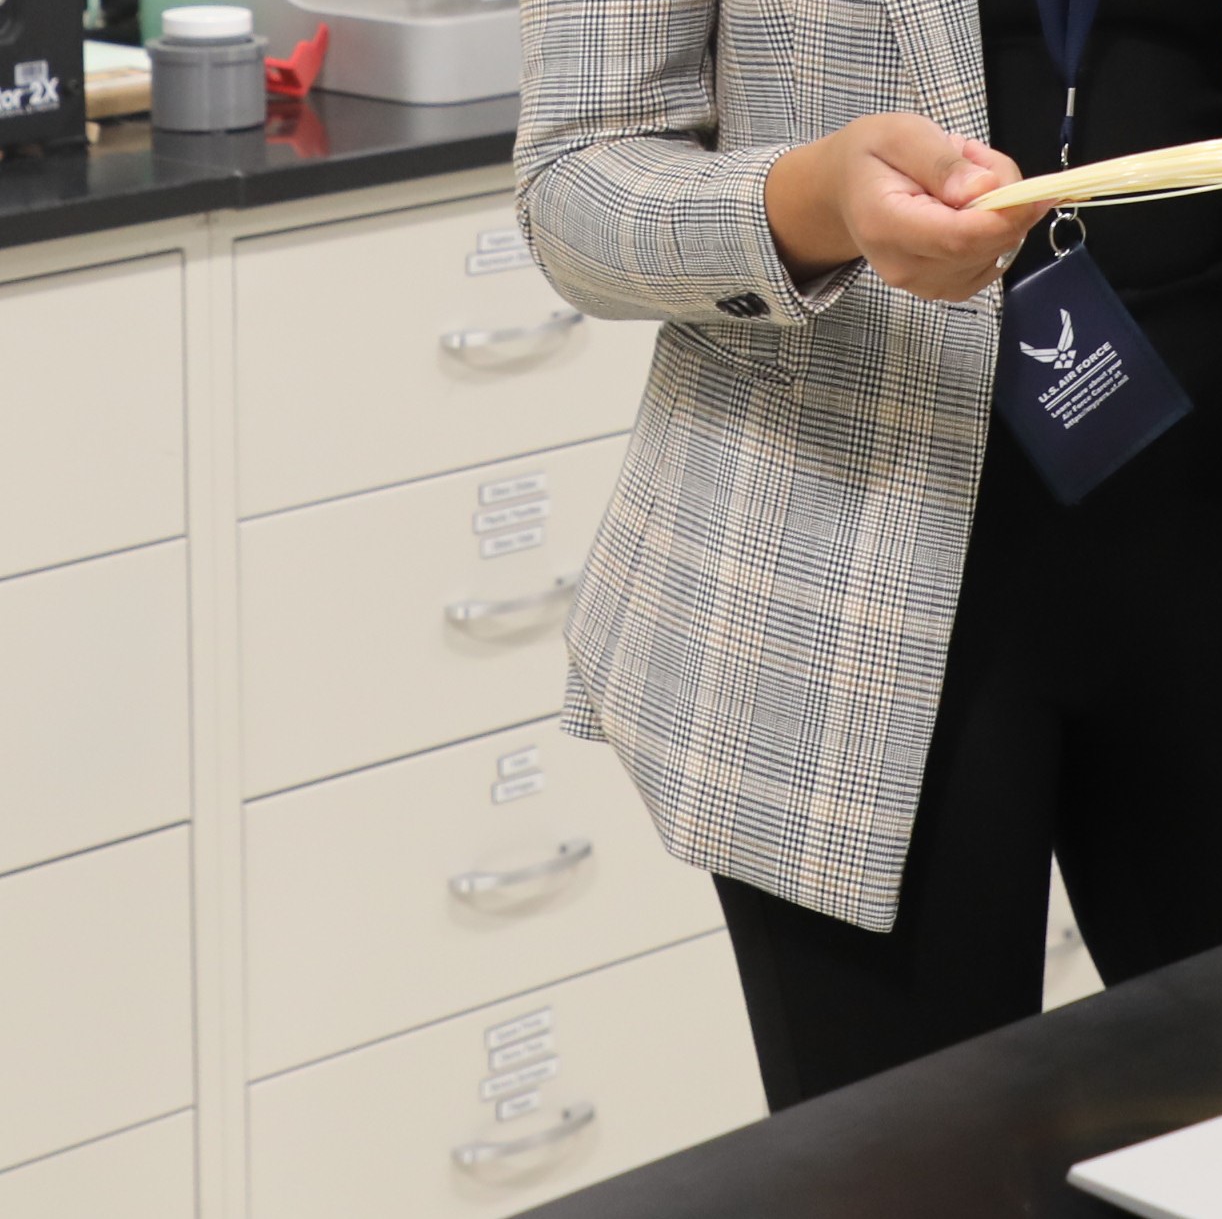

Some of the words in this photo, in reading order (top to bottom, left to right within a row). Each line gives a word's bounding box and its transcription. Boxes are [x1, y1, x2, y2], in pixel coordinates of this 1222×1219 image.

[28, 77, 60, 105] 2X
[1038, 385, 1060, 403] U.S.
[1058, 370, 1077, 389] AIR
[1075, 341, 1112, 373] FORCE
[1051, 400, 1072, 419] Learn
[1071, 387, 1089, 403] more
[1088, 370, 1107, 389] about
[1062, 410, 1073, 420] Air
[1073, 395, 1092, 413] Force
